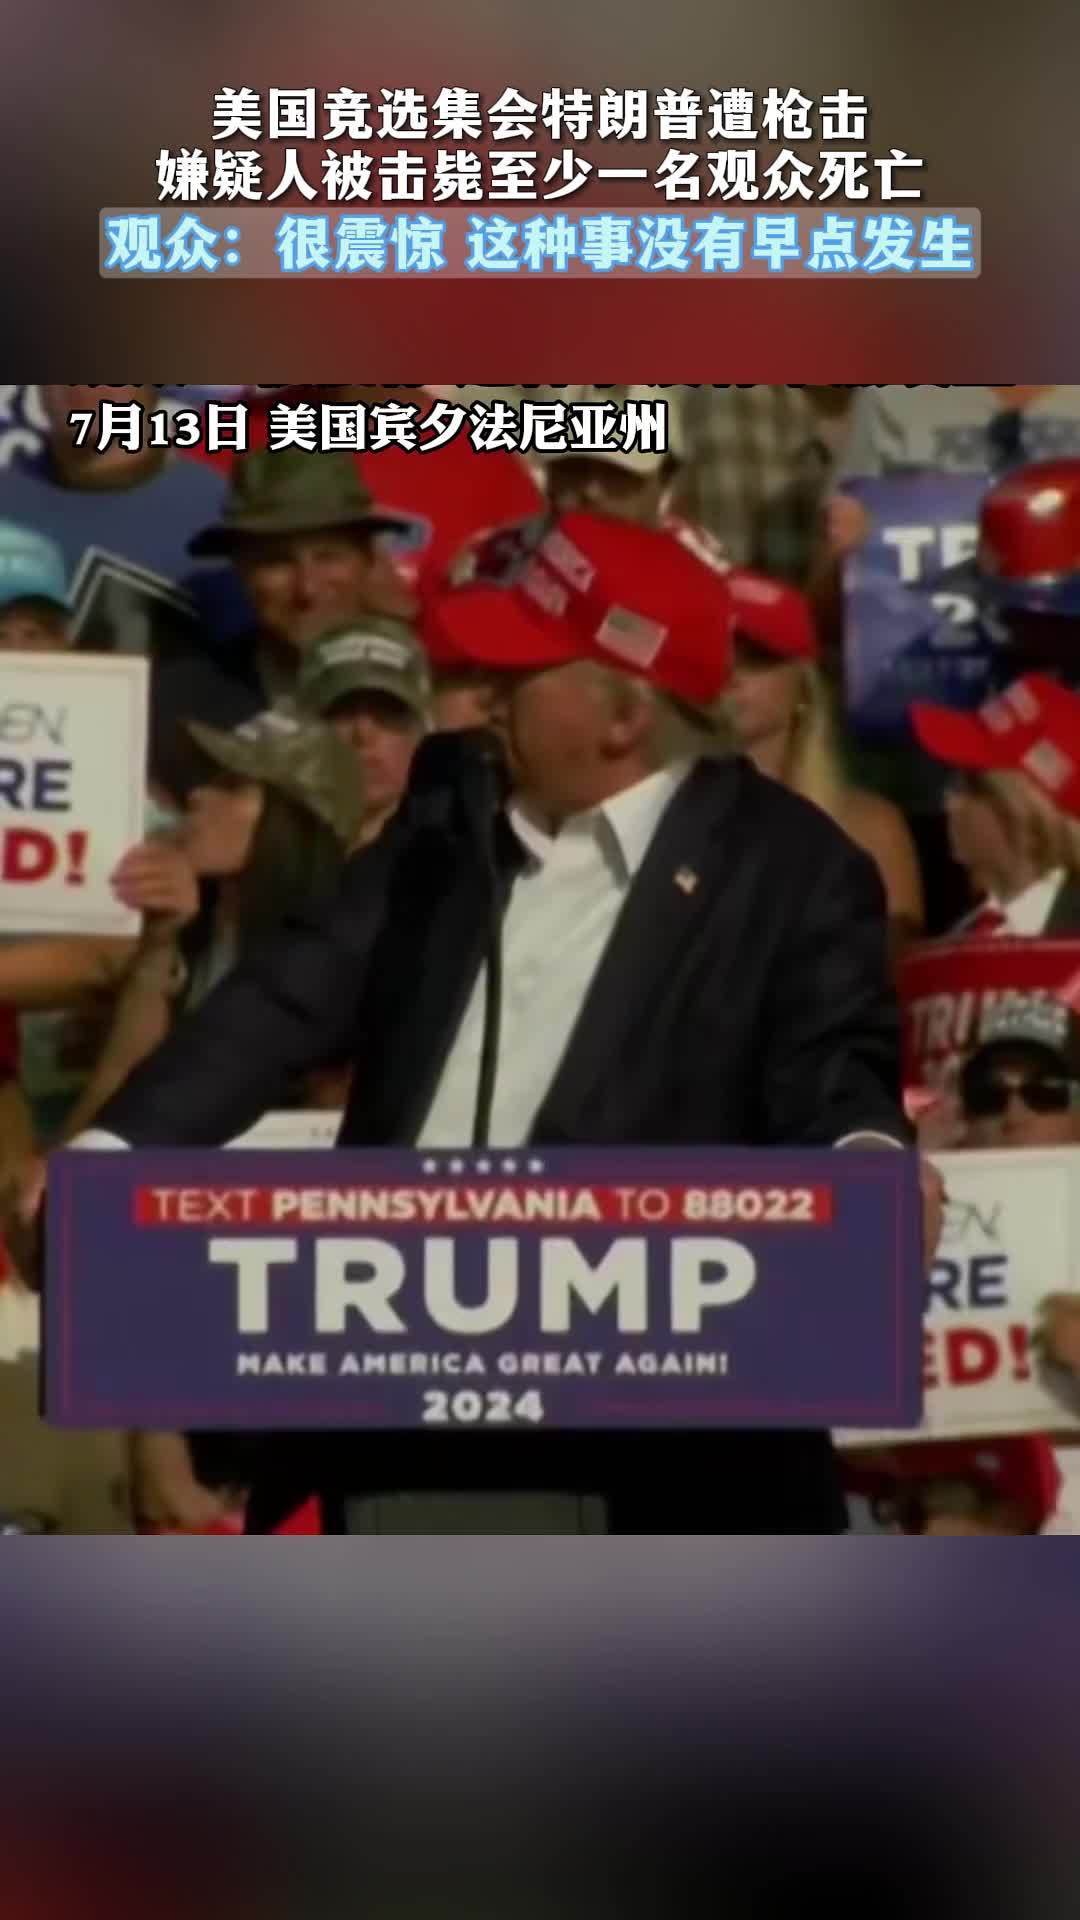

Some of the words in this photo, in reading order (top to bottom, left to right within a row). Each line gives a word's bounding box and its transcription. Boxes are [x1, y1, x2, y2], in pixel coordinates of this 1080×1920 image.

[152, 1188, 258, 1222] TEXT
[270, 1188, 602, 1222] PENNSYLVANIA
[614, 1188, 669, 1222] TO
[682, 1188, 815, 1222] 88022
[208, 1236, 758, 1335] TRUMP
[236, 1352, 327, 1376] MAKE
[338, 1352, 487, 1376] AMERICA
[497, 1352, 602, 1376] GREAT
[614, 1352, 728, 1376] AGAIN!
[421, 1390, 544, 1423] 2024
